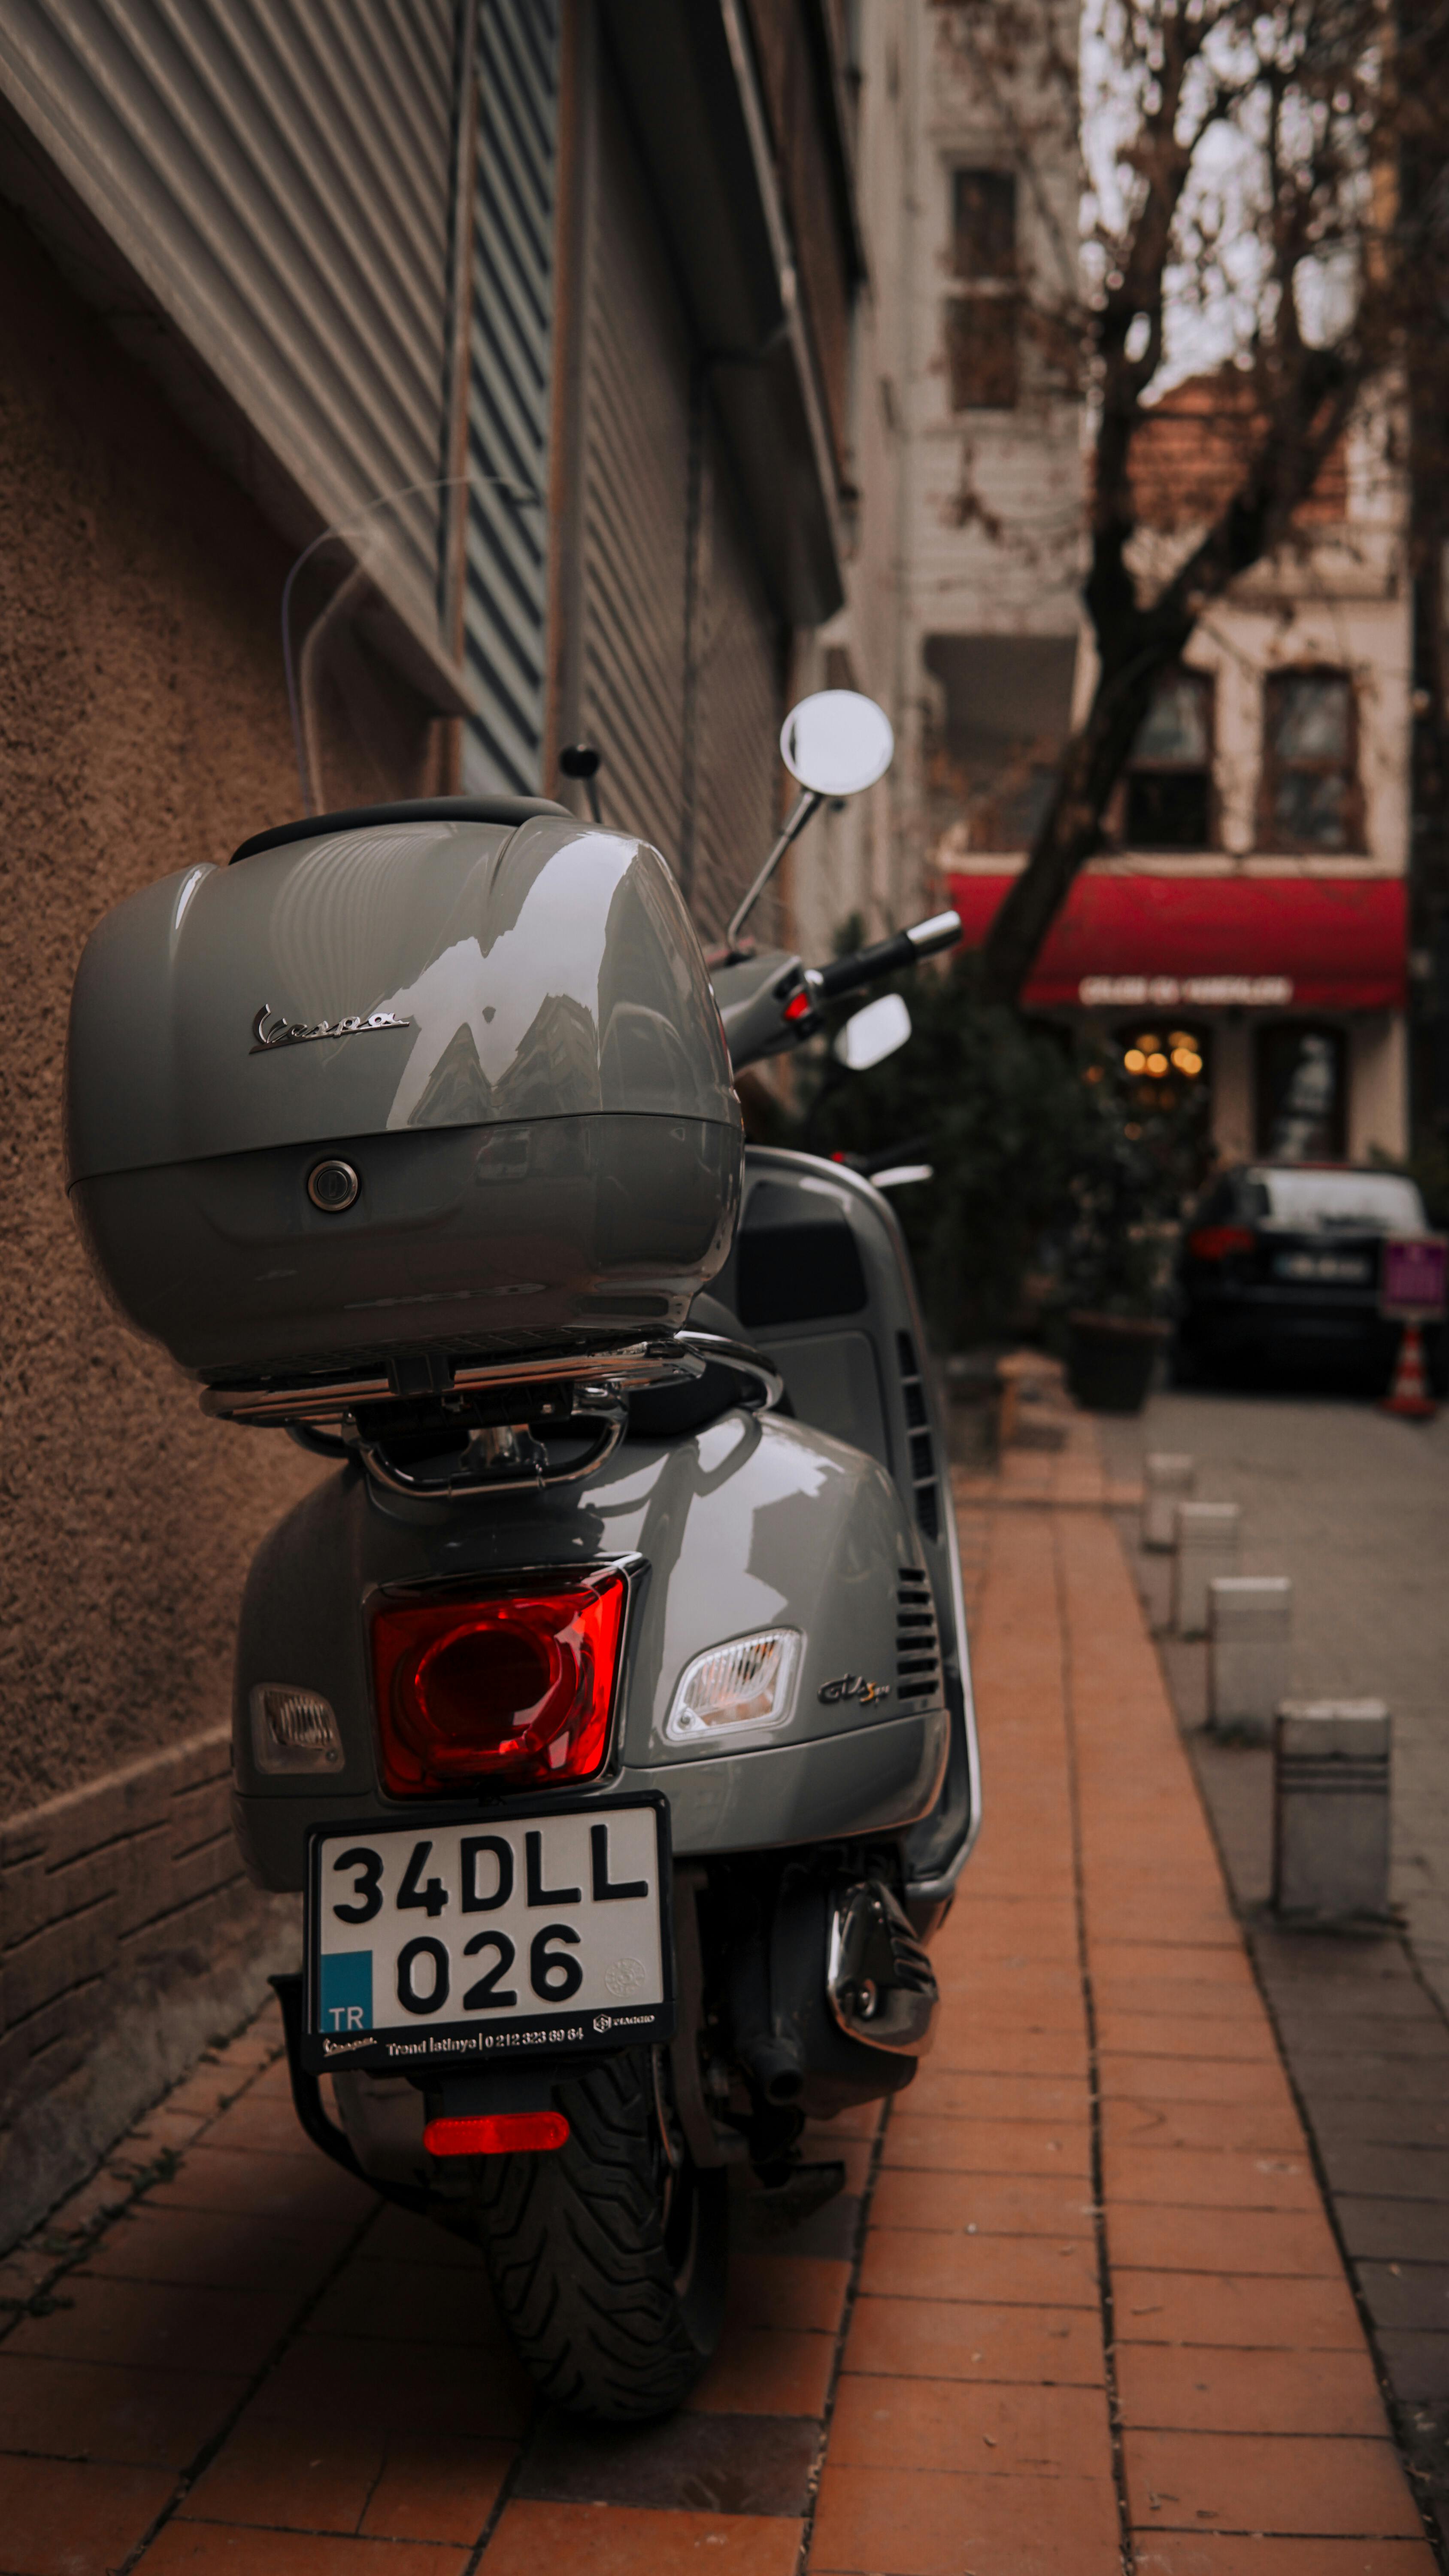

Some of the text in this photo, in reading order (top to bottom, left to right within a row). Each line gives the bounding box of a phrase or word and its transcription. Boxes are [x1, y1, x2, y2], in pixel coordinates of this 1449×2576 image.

[249, 1002, 410, 1055] Vespa
[396, 1923, 583, 2015] 026
[328, 2007, 364, 2032] TR
[385, 2040, 427, 2056] Trend
